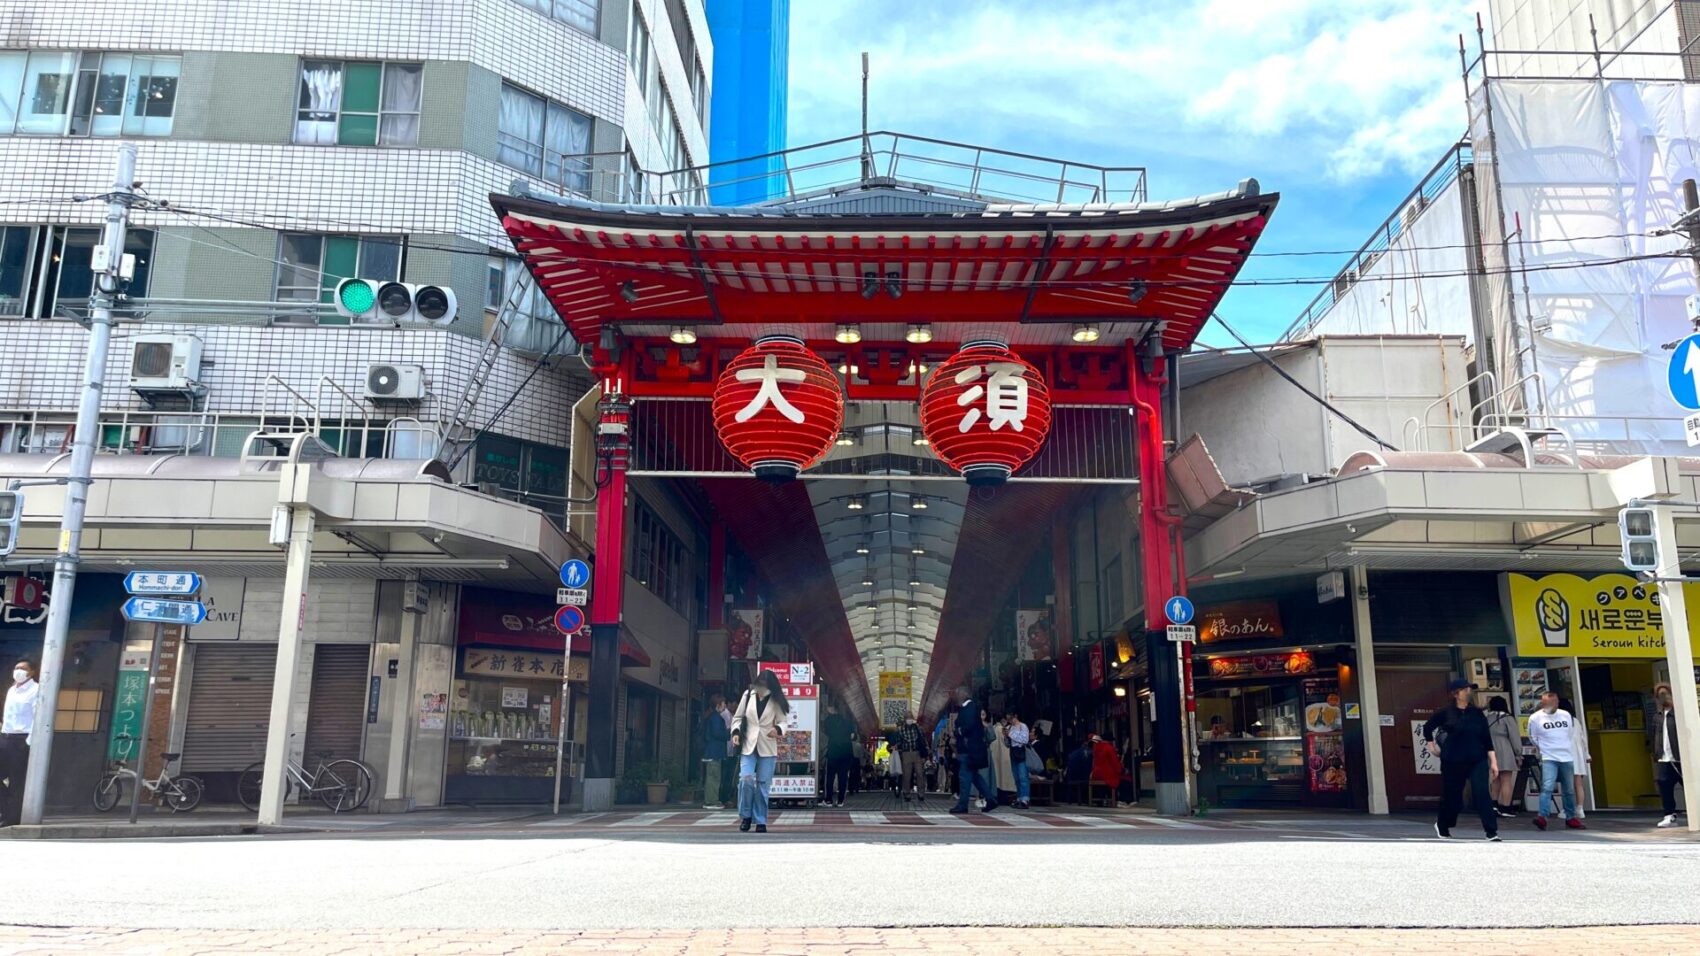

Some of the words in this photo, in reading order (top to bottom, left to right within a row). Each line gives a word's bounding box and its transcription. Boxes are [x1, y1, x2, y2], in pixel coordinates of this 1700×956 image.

[735, 354, 806, 424] 大
[955, 361, 1028, 434] 須
[138, 574, 186, 585] 本町通
[203, 597, 215, 606] A
[559, 596, 584, 604] 11-22
[205, 608, 240, 622] CAVE
[1593, 636, 1633, 648] Seroun
[490, 654, 565, 676] 新雀本店
[791, 665, 810, 674] N-2
